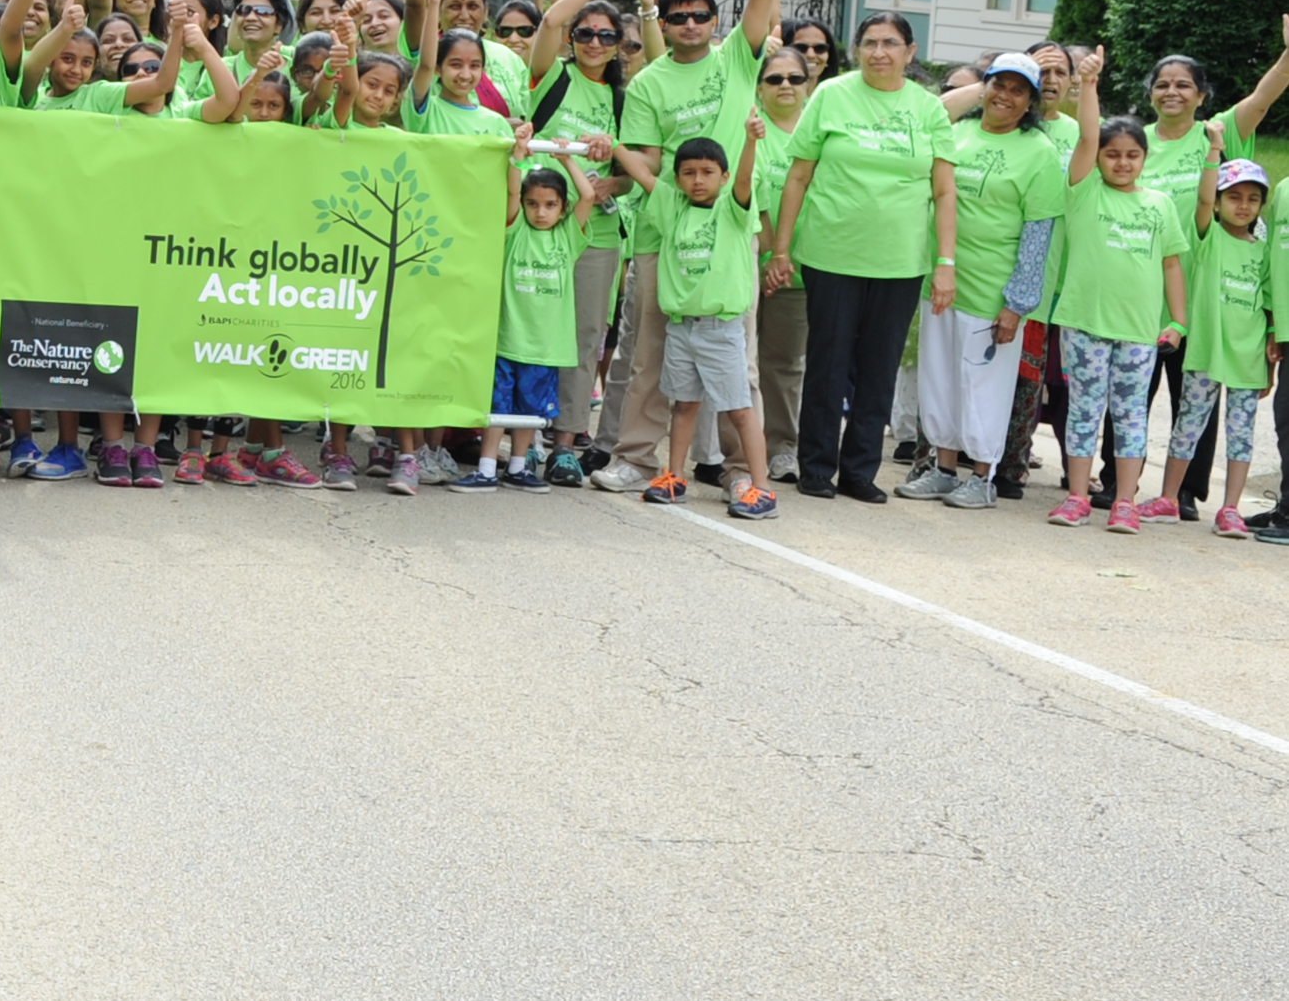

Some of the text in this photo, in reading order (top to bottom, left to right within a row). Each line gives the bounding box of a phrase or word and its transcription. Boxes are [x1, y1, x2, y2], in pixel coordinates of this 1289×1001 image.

[144, 234, 380, 285] Think globally
[1223, 270, 1258, 285] Globally
[198, 273, 378, 321] Act locally
[1230, 296, 1253, 308] GREEN
[35, 317, 105, 330] National Beneficiary
[10, 338, 93, 359] The Nature
[193, 341, 369, 372] WALK GREEN
[7, 353, 91, 376] Conservancy
[49, 376, 89, 387] nature.org
[330, 372, 366, 390] 2016
